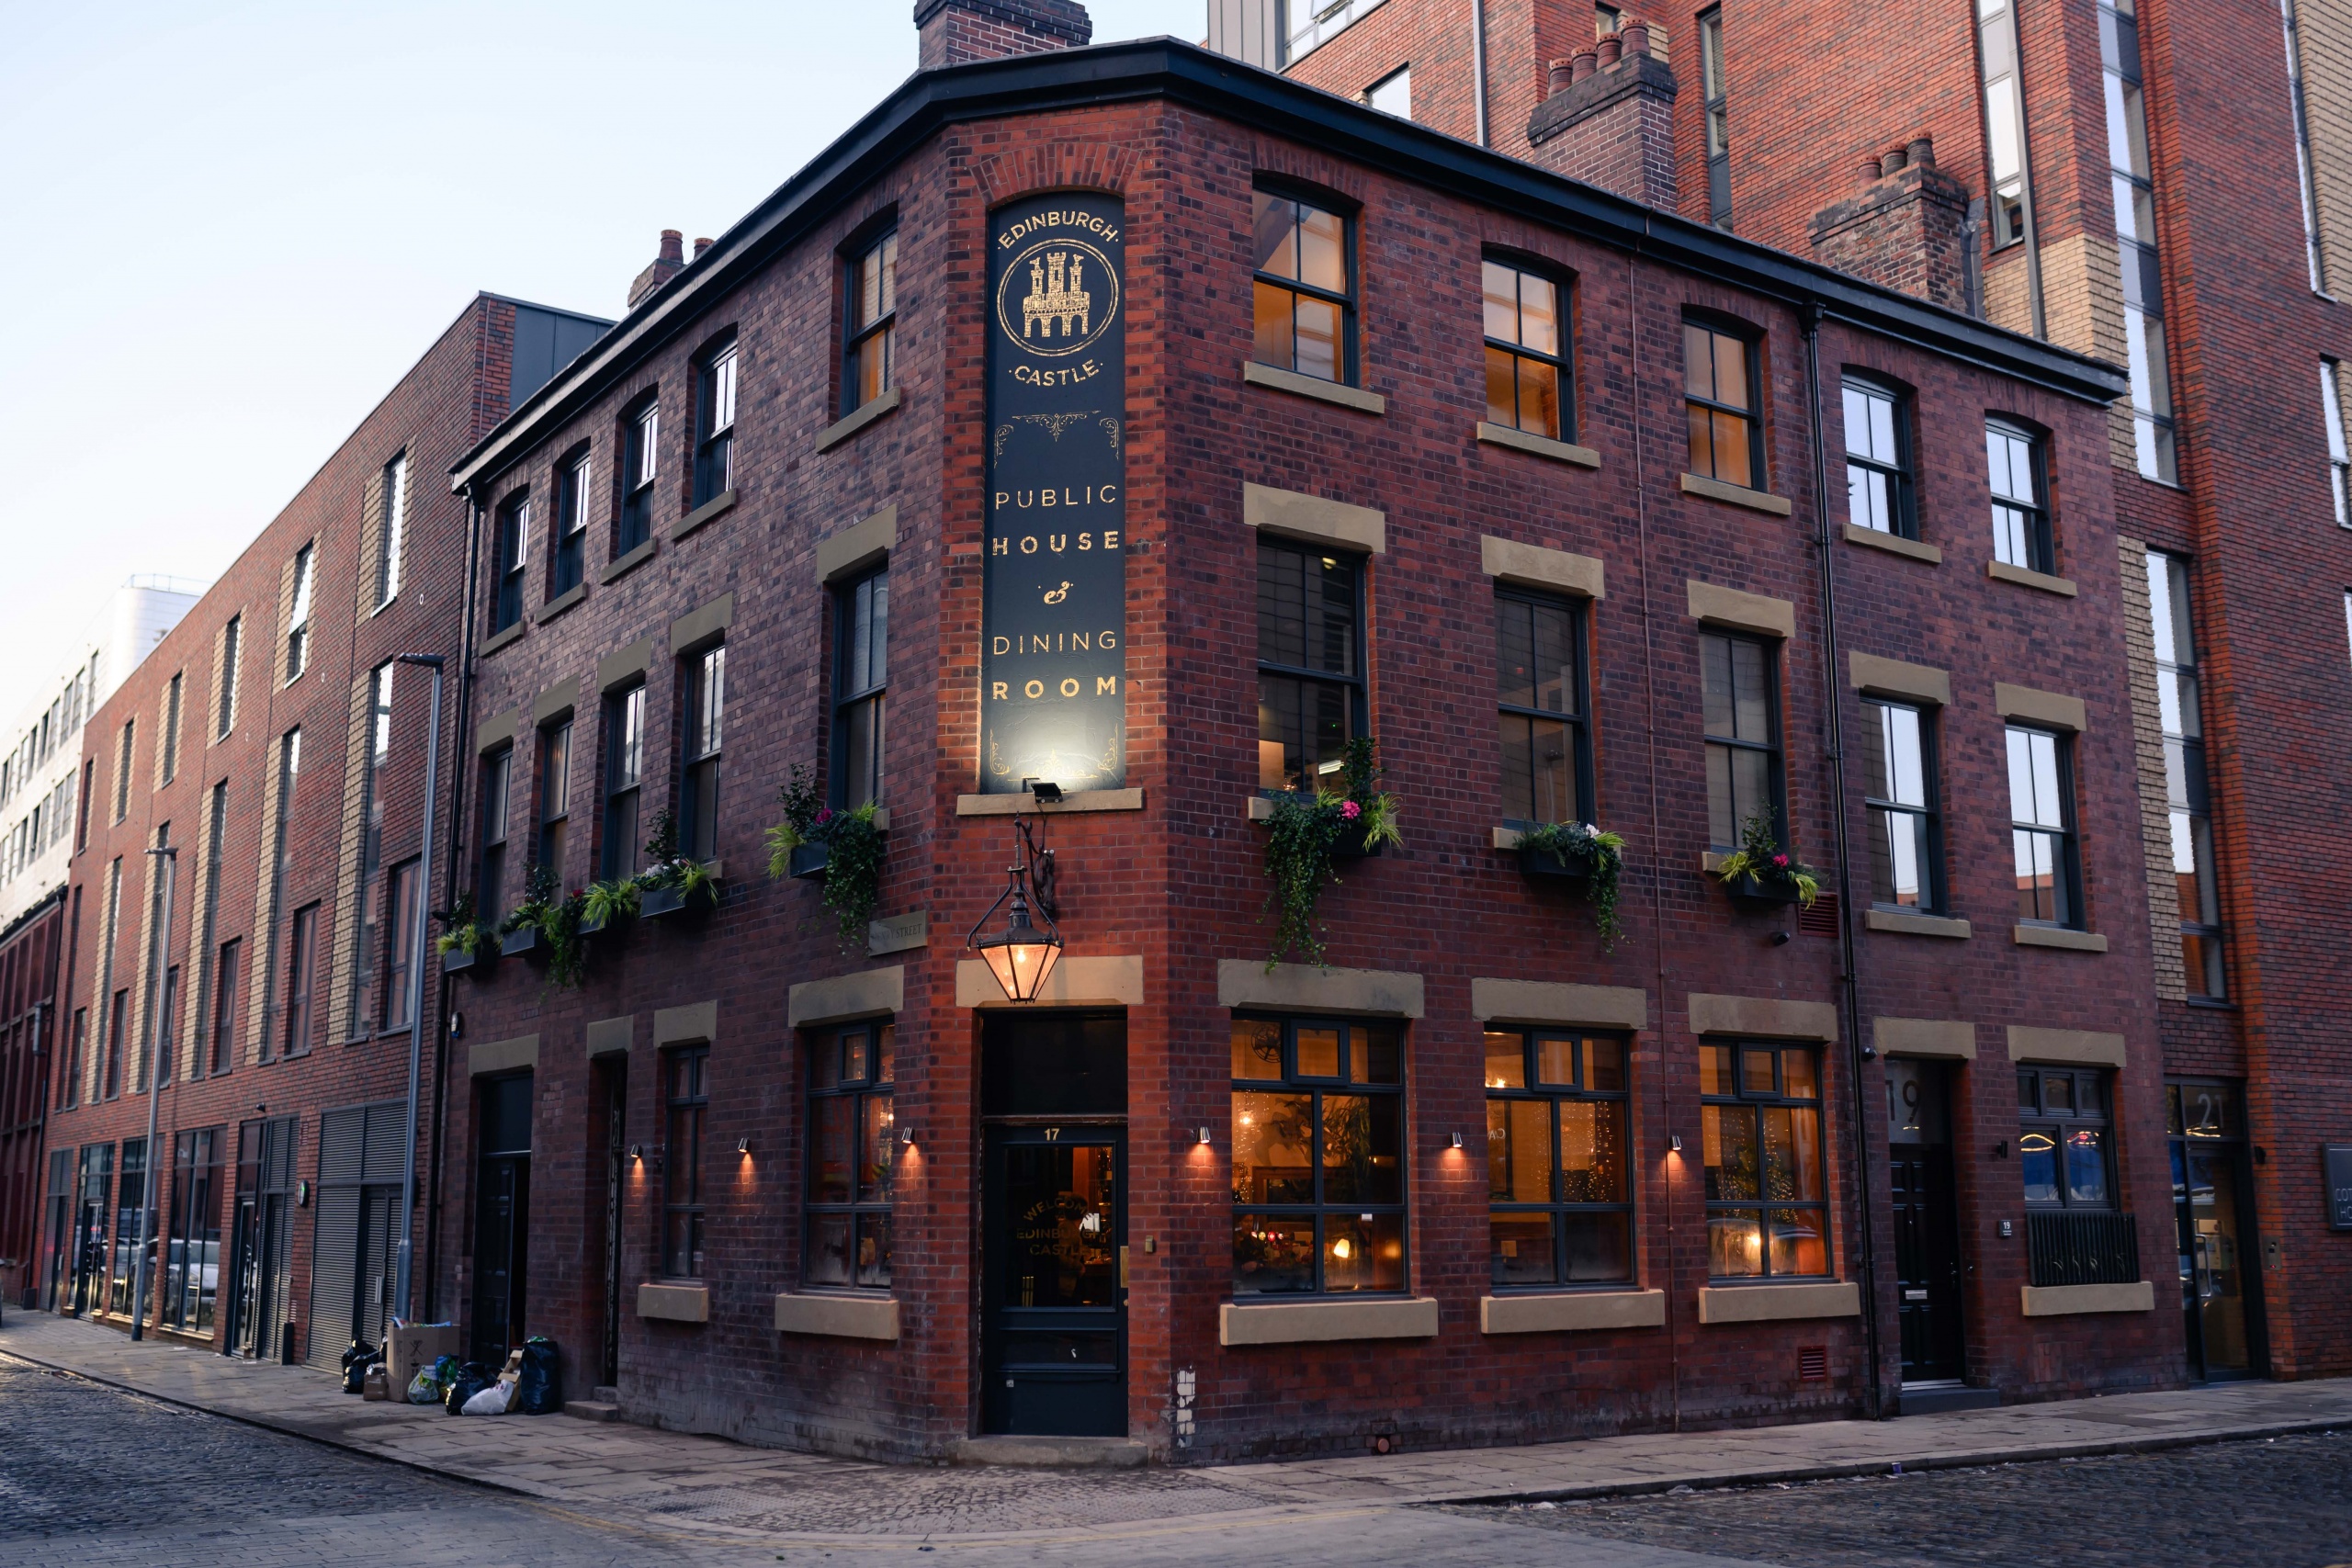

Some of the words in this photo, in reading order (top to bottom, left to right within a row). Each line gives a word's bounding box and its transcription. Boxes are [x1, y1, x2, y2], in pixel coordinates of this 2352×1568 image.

[998, 210, 1119, 250] EDINBURGH
[1013, 358, 1101, 387] CASTLE
[995, 484, 1116, 510] PUBLIC
[992, 530, 1119, 556] HOUSE
[993, 630, 1116, 655] DINING
[992, 676, 1116, 700] ROOM
[896, 923, 922, 939] STREET
[1884, 1079, 1920, 1123] 19
[2198, 1092, 2224, 1129] 21
[1045, 1128, 1060, 1141] 17
[1015, 1228, 1099, 1239] EDINBUGH
[2003, 1221, 2010, 1230] 19
[1029, 1242, 1089, 1256] CASTLE
